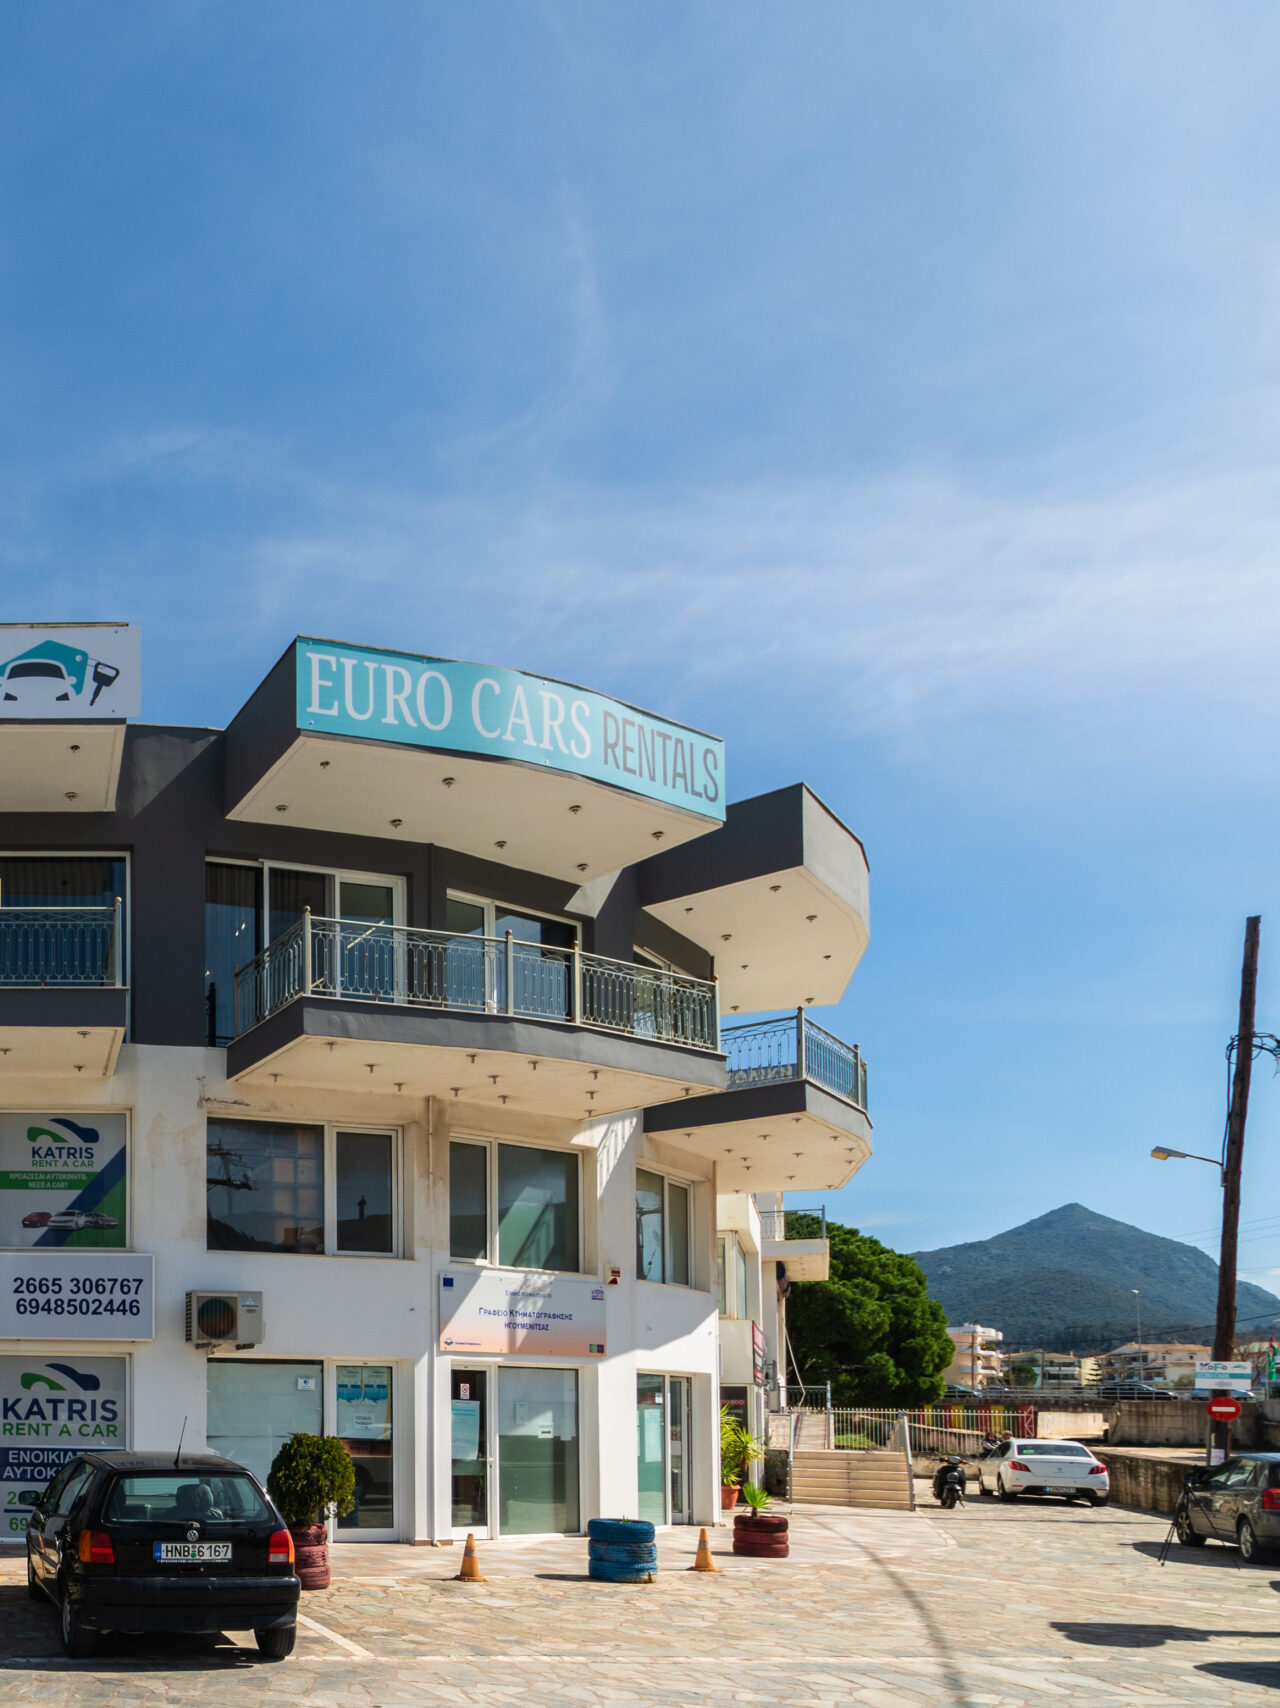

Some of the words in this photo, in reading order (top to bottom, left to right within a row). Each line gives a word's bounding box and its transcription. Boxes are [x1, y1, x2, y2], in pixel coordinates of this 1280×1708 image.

[306, 652, 454, 731] EURO
[471, 678, 592, 760] CARS
[603, 710, 720, 804] RENTALS
[32, 1146, 94, 1160] KATRIS
[32, 1160, 59, 1168] RENT
[62, 1160, 71, 1168] A
[72, 1160, 94, 1168] CAR
[13, 1277, 63, 1295] 2665
[70, 1278, 144, 1296] 306767
[15, 1298, 141, 1316] 6948502446
[2, 1398, 118, 1422] KATRIS
[2, 1422, 52, 1436] RENT
[58, 1423, 72, 1437] A
[78, 1423, 118, 1437] CAR
[8, 1450, 86, 1464] ΕΝΟΙΚΙΑ
[165, 1544, 190, 1558] HNB
[197, 1544, 230, 1558] 6167
